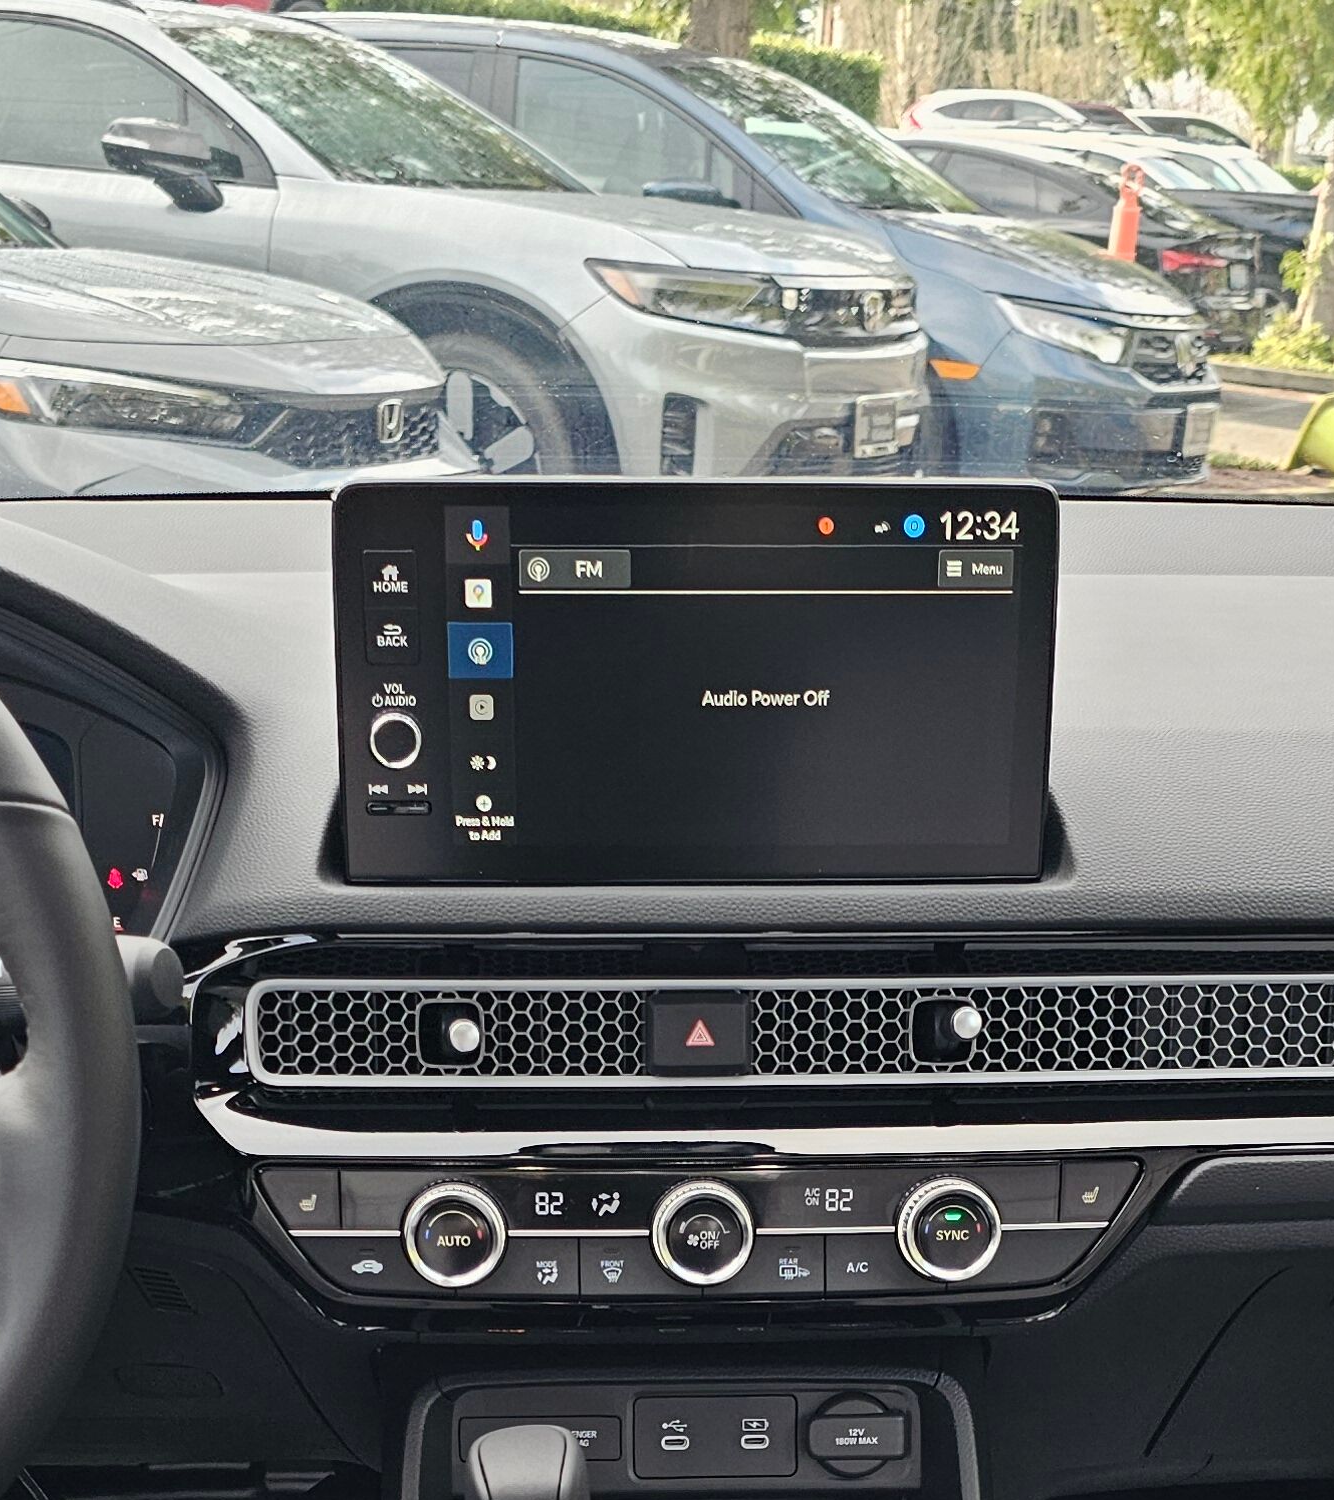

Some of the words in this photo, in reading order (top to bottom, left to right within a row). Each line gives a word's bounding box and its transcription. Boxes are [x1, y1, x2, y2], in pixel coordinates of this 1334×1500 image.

[939, 510, 1020, 541] 12:34
[575, 560, 603, 578] FM
[972, 562, 1004, 576] Menu
[373, 581, 408, 593] HOME
[376, 636, 408, 648] BACK
[383, 683, 406, 695] VOL
[385, 695, 417, 707] AUDIO
[701, 690, 748, 707] Audio
[751, 690, 801, 707] Power
[803, 690, 830, 707] Off
[482, 815, 490, 827] &
[491, 815, 514, 827] Hold
[469, 830, 480, 841] to
[481, 830, 501, 841] Add
[113, 917, 121, 928] E
[804, 1188, 820, 1197] A/C
[535, 1192, 564, 1215] 82
[806, 1197, 820, 1206] ON
[825, 1188, 853, 1212] 82
[437, 1235, 472, 1248] AUTO
[700, 1230, 720, 1241] ON/
[936, 1230, 970, 1241] SYNC
[700, 1241, 720, 1250] OFF
[601, 1260, 624, 1268] FRONT
[847, 1262, 869, 1273] A/C
[848, 1428, 865, 1437] 12V
[858, 1437, 879, 1445] MAX
